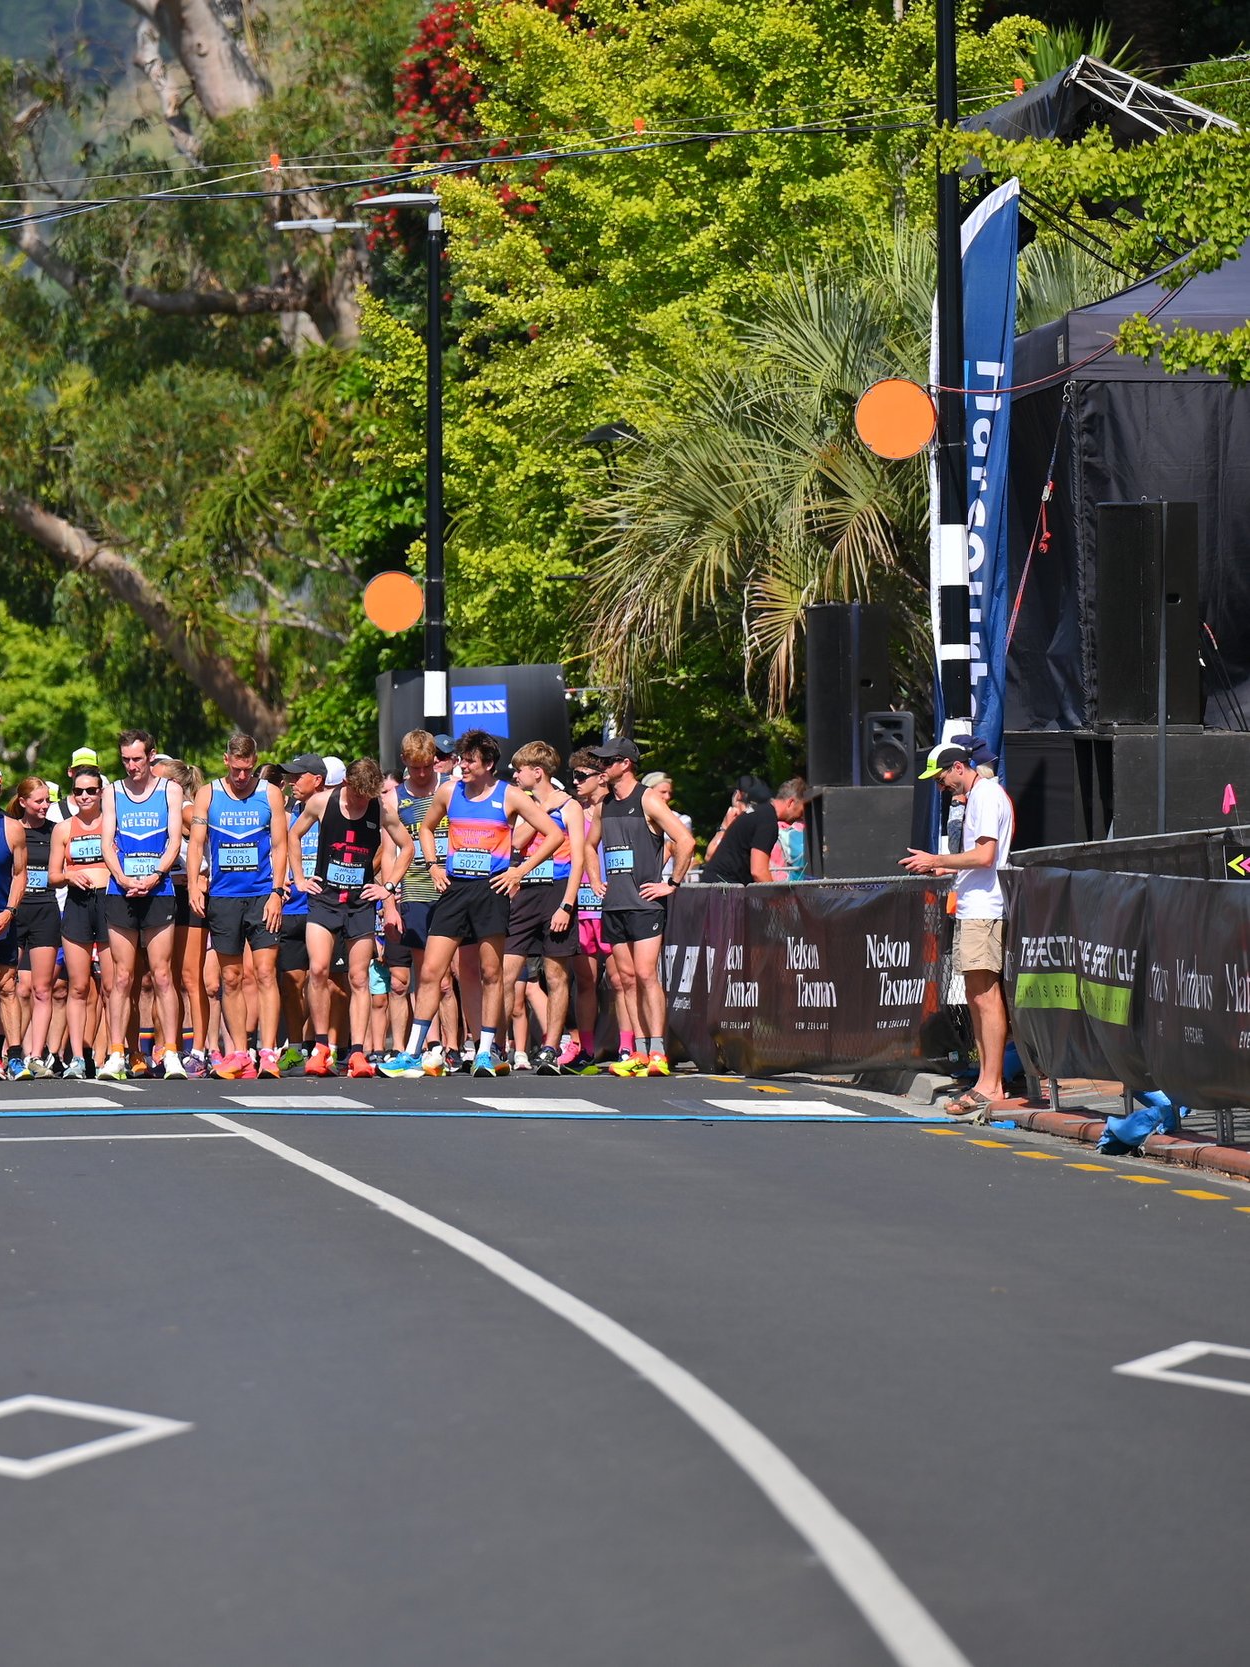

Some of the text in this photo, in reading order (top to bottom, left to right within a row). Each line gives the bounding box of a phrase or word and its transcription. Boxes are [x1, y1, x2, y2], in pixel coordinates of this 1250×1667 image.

[453, 699, 507, 715] ZEISS
[121, 818, 160, 828] NELSON
[219, 817, 260, 826] NELSON
[78, 847, 101, 856] 5115
[226, 855, 251, 864] 5033
[459, 859, 483, 869] 5027
[132, 864, 156, 873] 5018
[527, 867, 546, 876] 107
[333, 872, 357, 883] 5032
[786, 936, 820, 970] Nelson
[865, 934, 910, 969] Nelson
[796, 974, 838, 1008] Tasman
[878, 972, 926, 1007] Tasman
[876, 1021, 887, 1029] NEW
